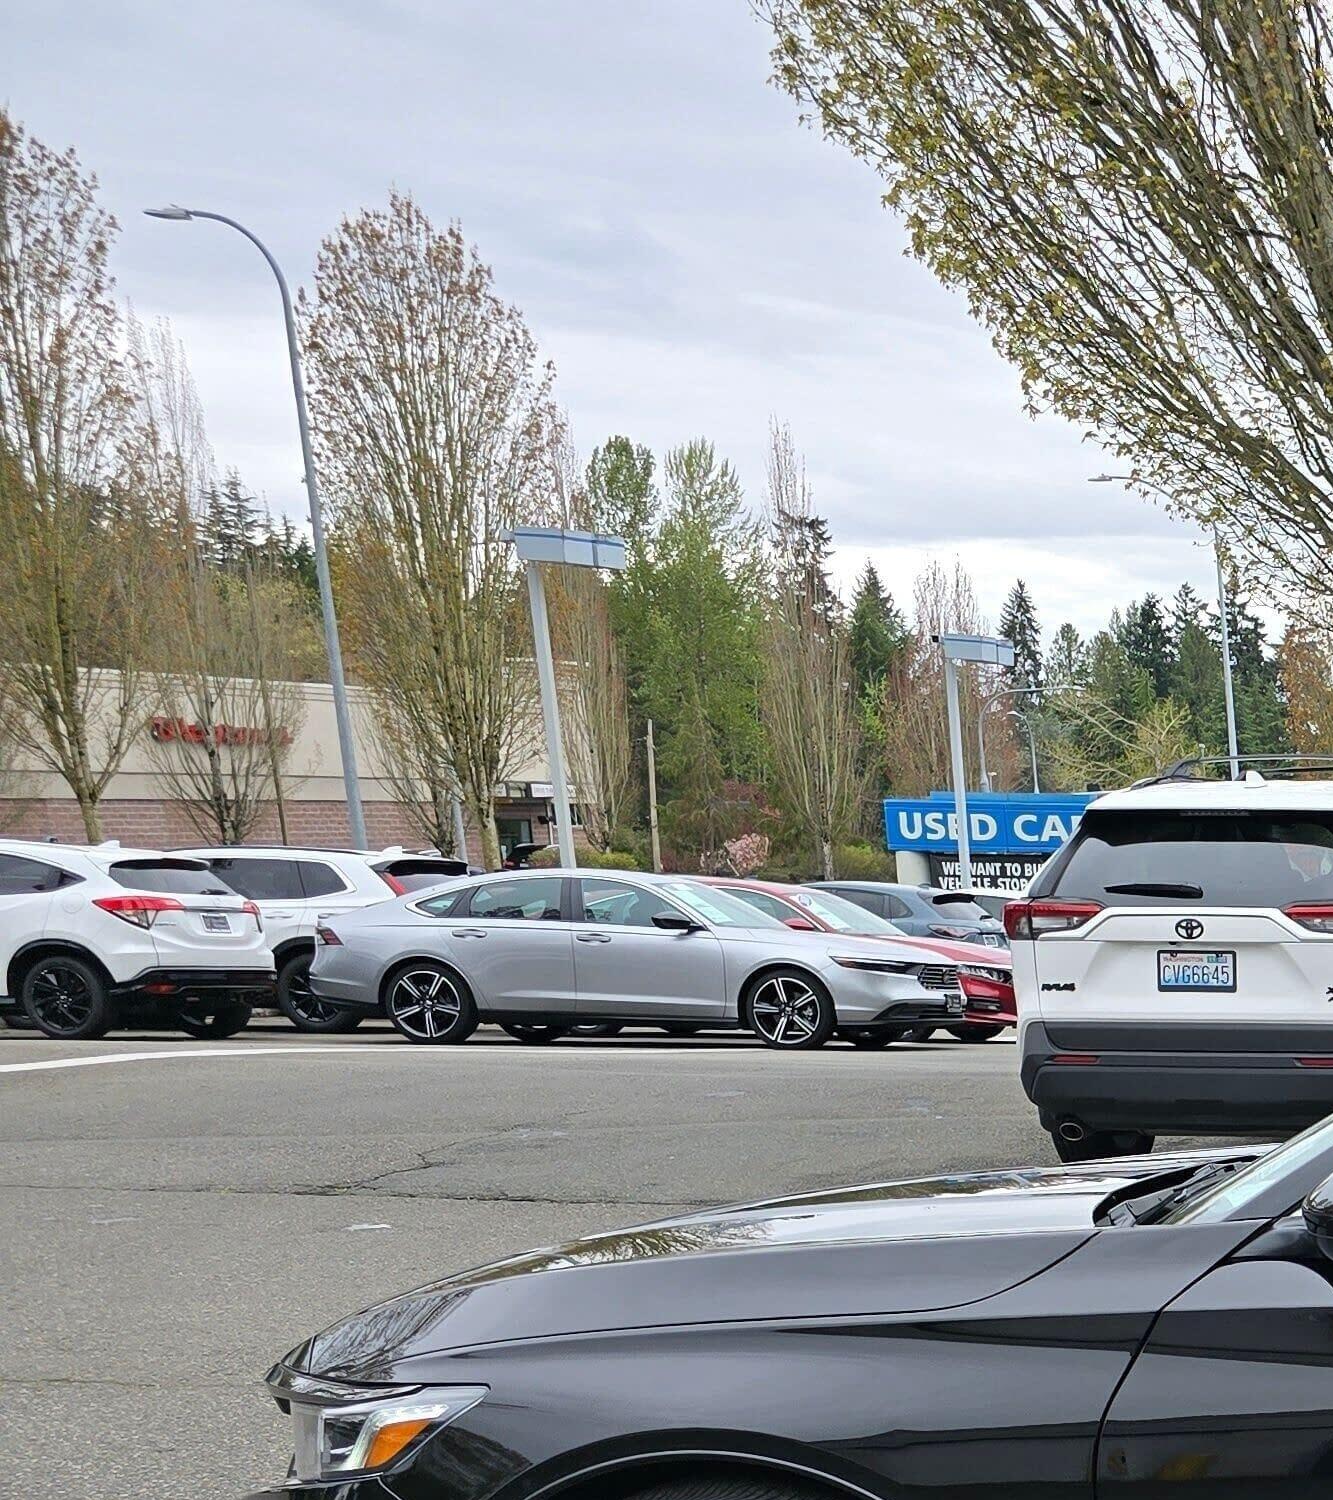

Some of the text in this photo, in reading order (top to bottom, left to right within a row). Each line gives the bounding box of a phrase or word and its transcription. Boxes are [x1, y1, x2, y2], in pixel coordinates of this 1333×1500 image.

[941, 861, 961, 876] WE
[1005, 863, 1022, 876] TO
[1162, 964, 1230, 984] CVG6645
